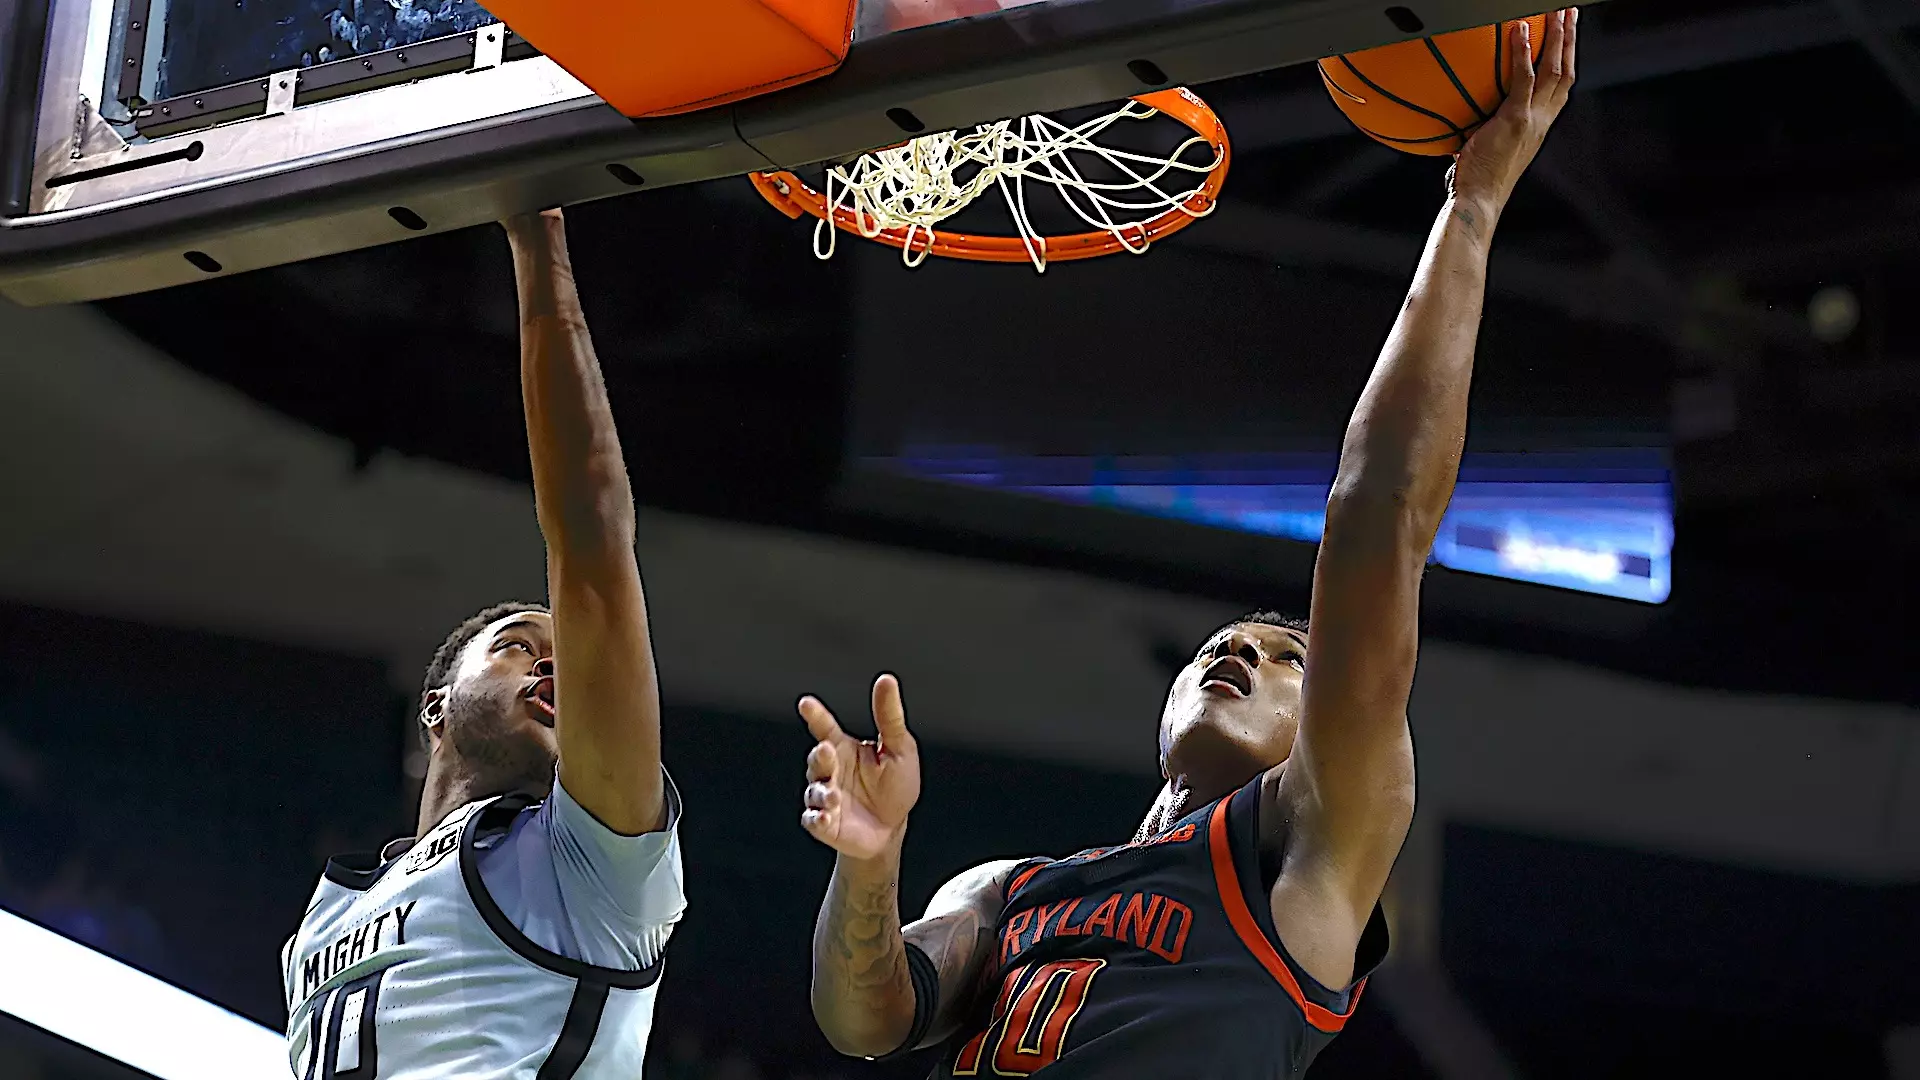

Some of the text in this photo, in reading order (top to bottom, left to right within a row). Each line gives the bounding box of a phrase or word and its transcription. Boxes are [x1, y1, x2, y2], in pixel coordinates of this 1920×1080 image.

[303, 900, 418, 1000] MIGHTY
[1000, 893, 1194, 964] RYLAND
[951, 957, 1107, 1076] 10
